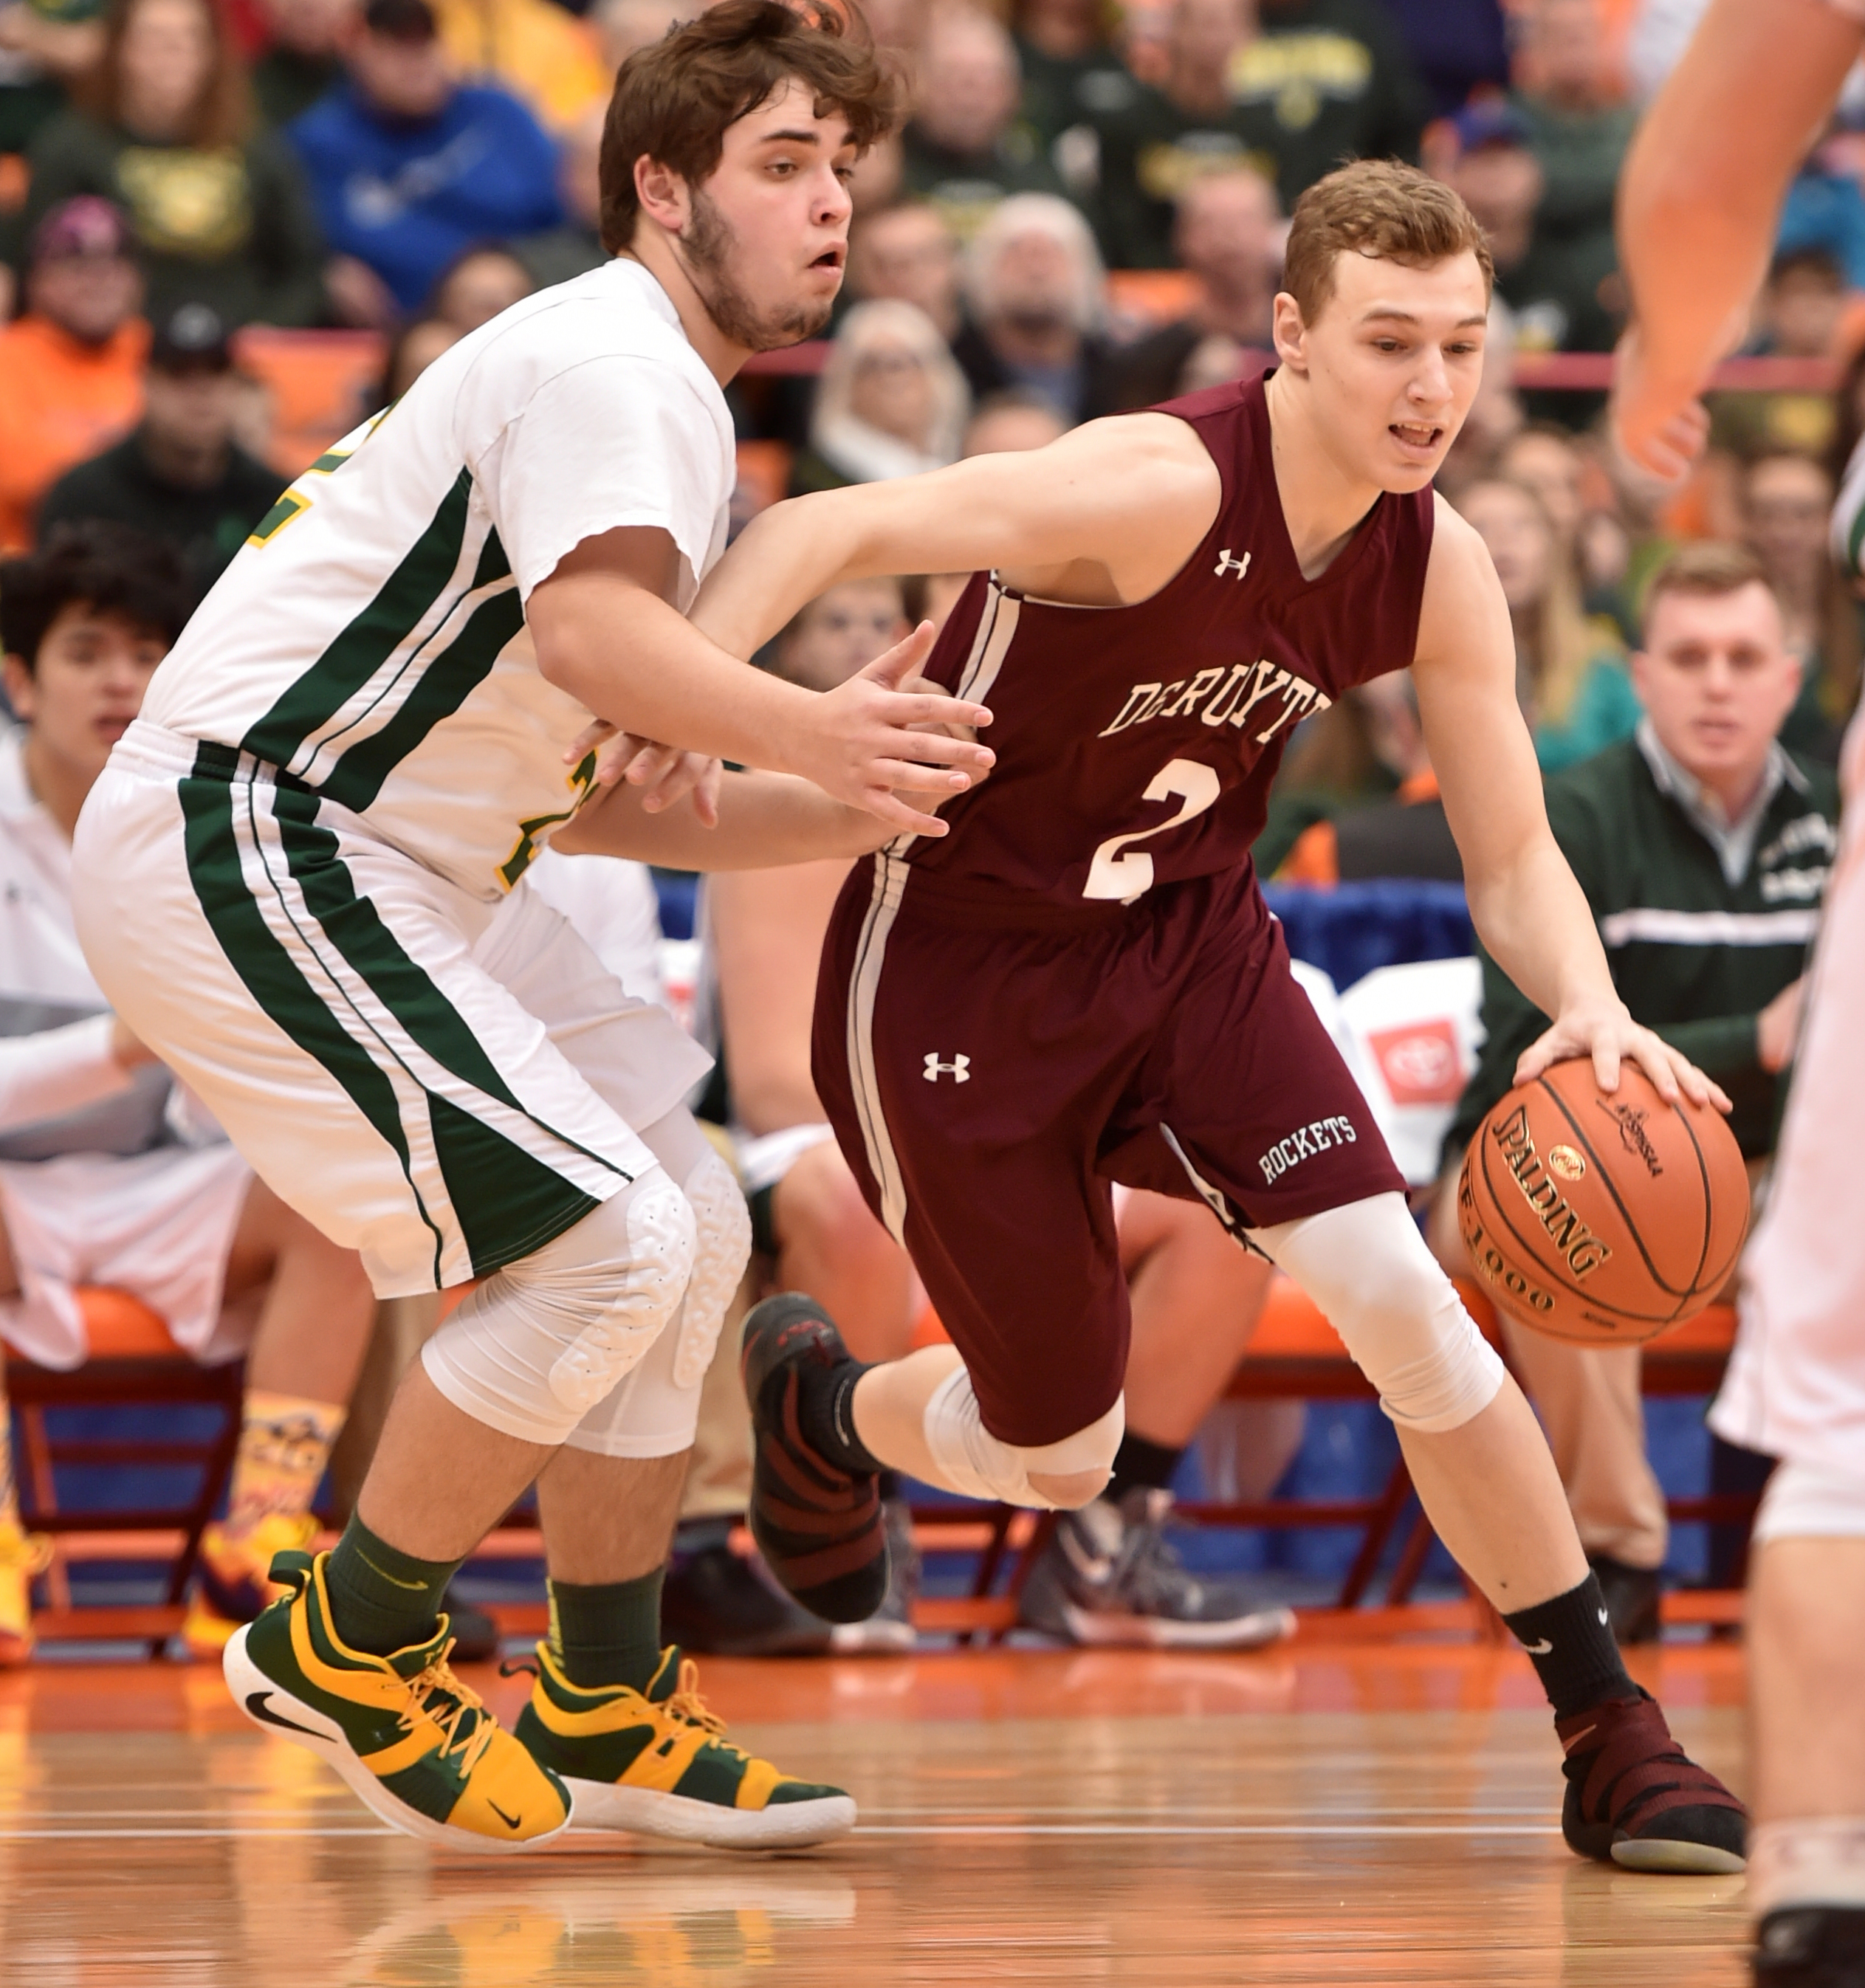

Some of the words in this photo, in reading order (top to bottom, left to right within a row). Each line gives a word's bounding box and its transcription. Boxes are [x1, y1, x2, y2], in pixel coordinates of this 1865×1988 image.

[1082, 758, 1221, 905] 2
[1258, 1115, 1357, 1186] ROCKETS
[1492, 1103, 1612, 1282] SPALDING
